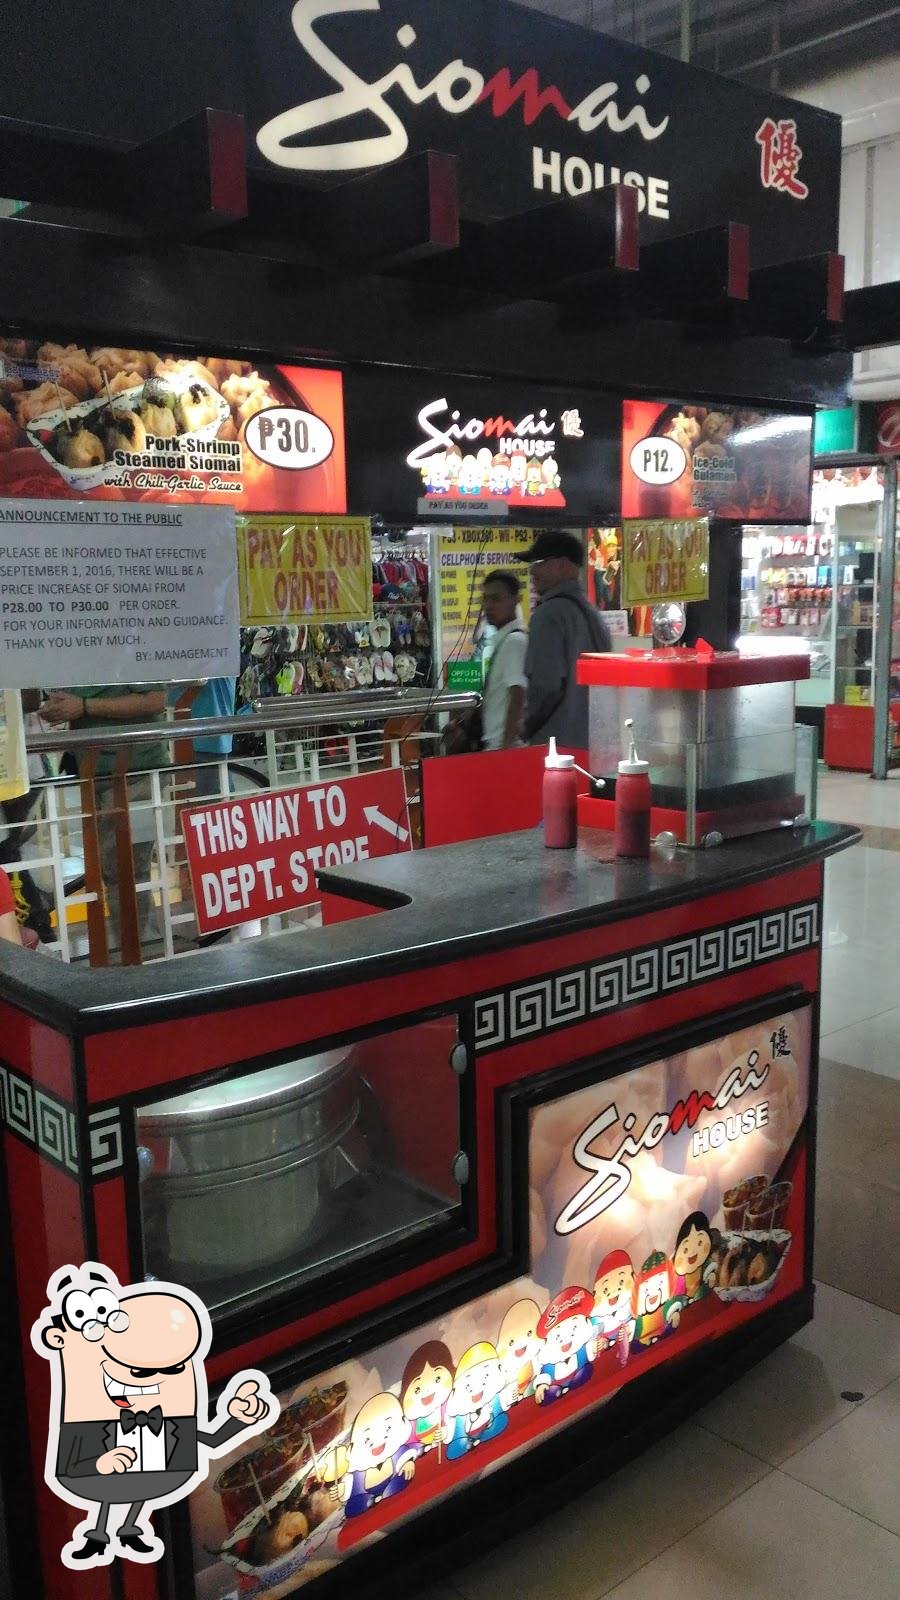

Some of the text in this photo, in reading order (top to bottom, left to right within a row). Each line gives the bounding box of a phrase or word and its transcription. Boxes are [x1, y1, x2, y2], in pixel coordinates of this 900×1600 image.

[256, 0, 669, 170] Siomai
[406, 398, 555, 468] Siomai
[145, 435, 240, 456] Pork-Shrimp
[500, 438, 555, 457] HOUSE
[115, 452, 241, 472] Steamed Siomai
[104, 475, 131, 488] with
[135, 474, 204, 492] Chili-Garlic
[208, 480, 242, 492] Sauce
[0, 510, 183, 525] ANNOUNCEMENT TO THE PUBLIC
[0, 547, 207, 559] PLEASE BE INFORMED THAT EFFECTIVE
[248, 528, 361, 570] PAY AS YOU
[629, 529, 653, 563] PAY
[441, 552, 486, 567] CELLPHONE
[0, 565, 204, 578] SEPTEMBER 1, 2016, THERE WILL BE A
[644, 562, 687, 596] ORDER
[1, 582, 186, 595] PRICE INCREASE OF SIOMAI FROM
[273, 571, 340, 611] ORDER
[2, 601, 43, 613] P28.00
[48, 601, 65, 612] TO
[71, 600, 109, 612] P30.00
[119, 600, 139, 611] PER
[3, 615, 229, 632] FOR YOUR INFORMATION AND GUIDANCE.
[5, 638, 45, 650] THANK
[48, 637, 73, 649] YOU
[76, 636, 103, 648] VERY
[135, 647, 229, 662] BY: MANAGEMENT
[190, 784, 346, 857] THIS WAY TO
[201, 857, 283, 918] DEPT.
[693, 1101, 769, 1157] HOUSE
[554, 1050, 770, 1236] Siomai
